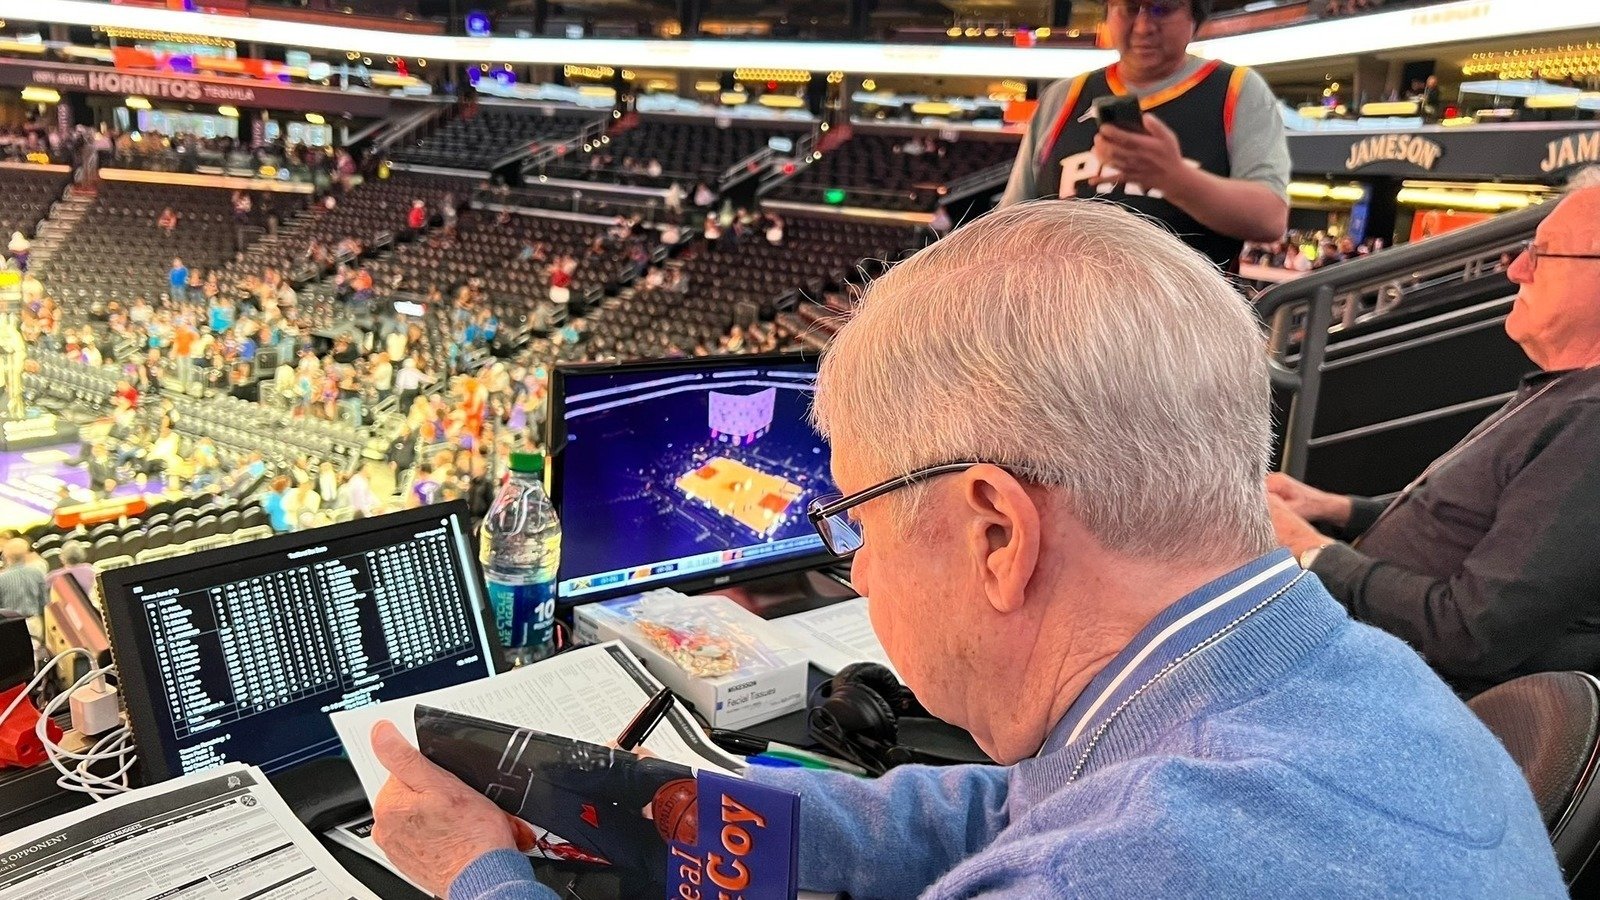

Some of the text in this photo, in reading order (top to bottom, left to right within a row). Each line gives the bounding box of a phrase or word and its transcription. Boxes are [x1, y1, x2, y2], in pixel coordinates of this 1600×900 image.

[88, 71, 202, 99] HORNITOS
[203, 86, 255, 101] TEQUILA
[1345, 134, 1443, 170] JAMESON
[727, 688, 776, 707] Facial Tissues
[8, 832, 69, 862] OPPONENT
[671, 845, 702, 900] eal
